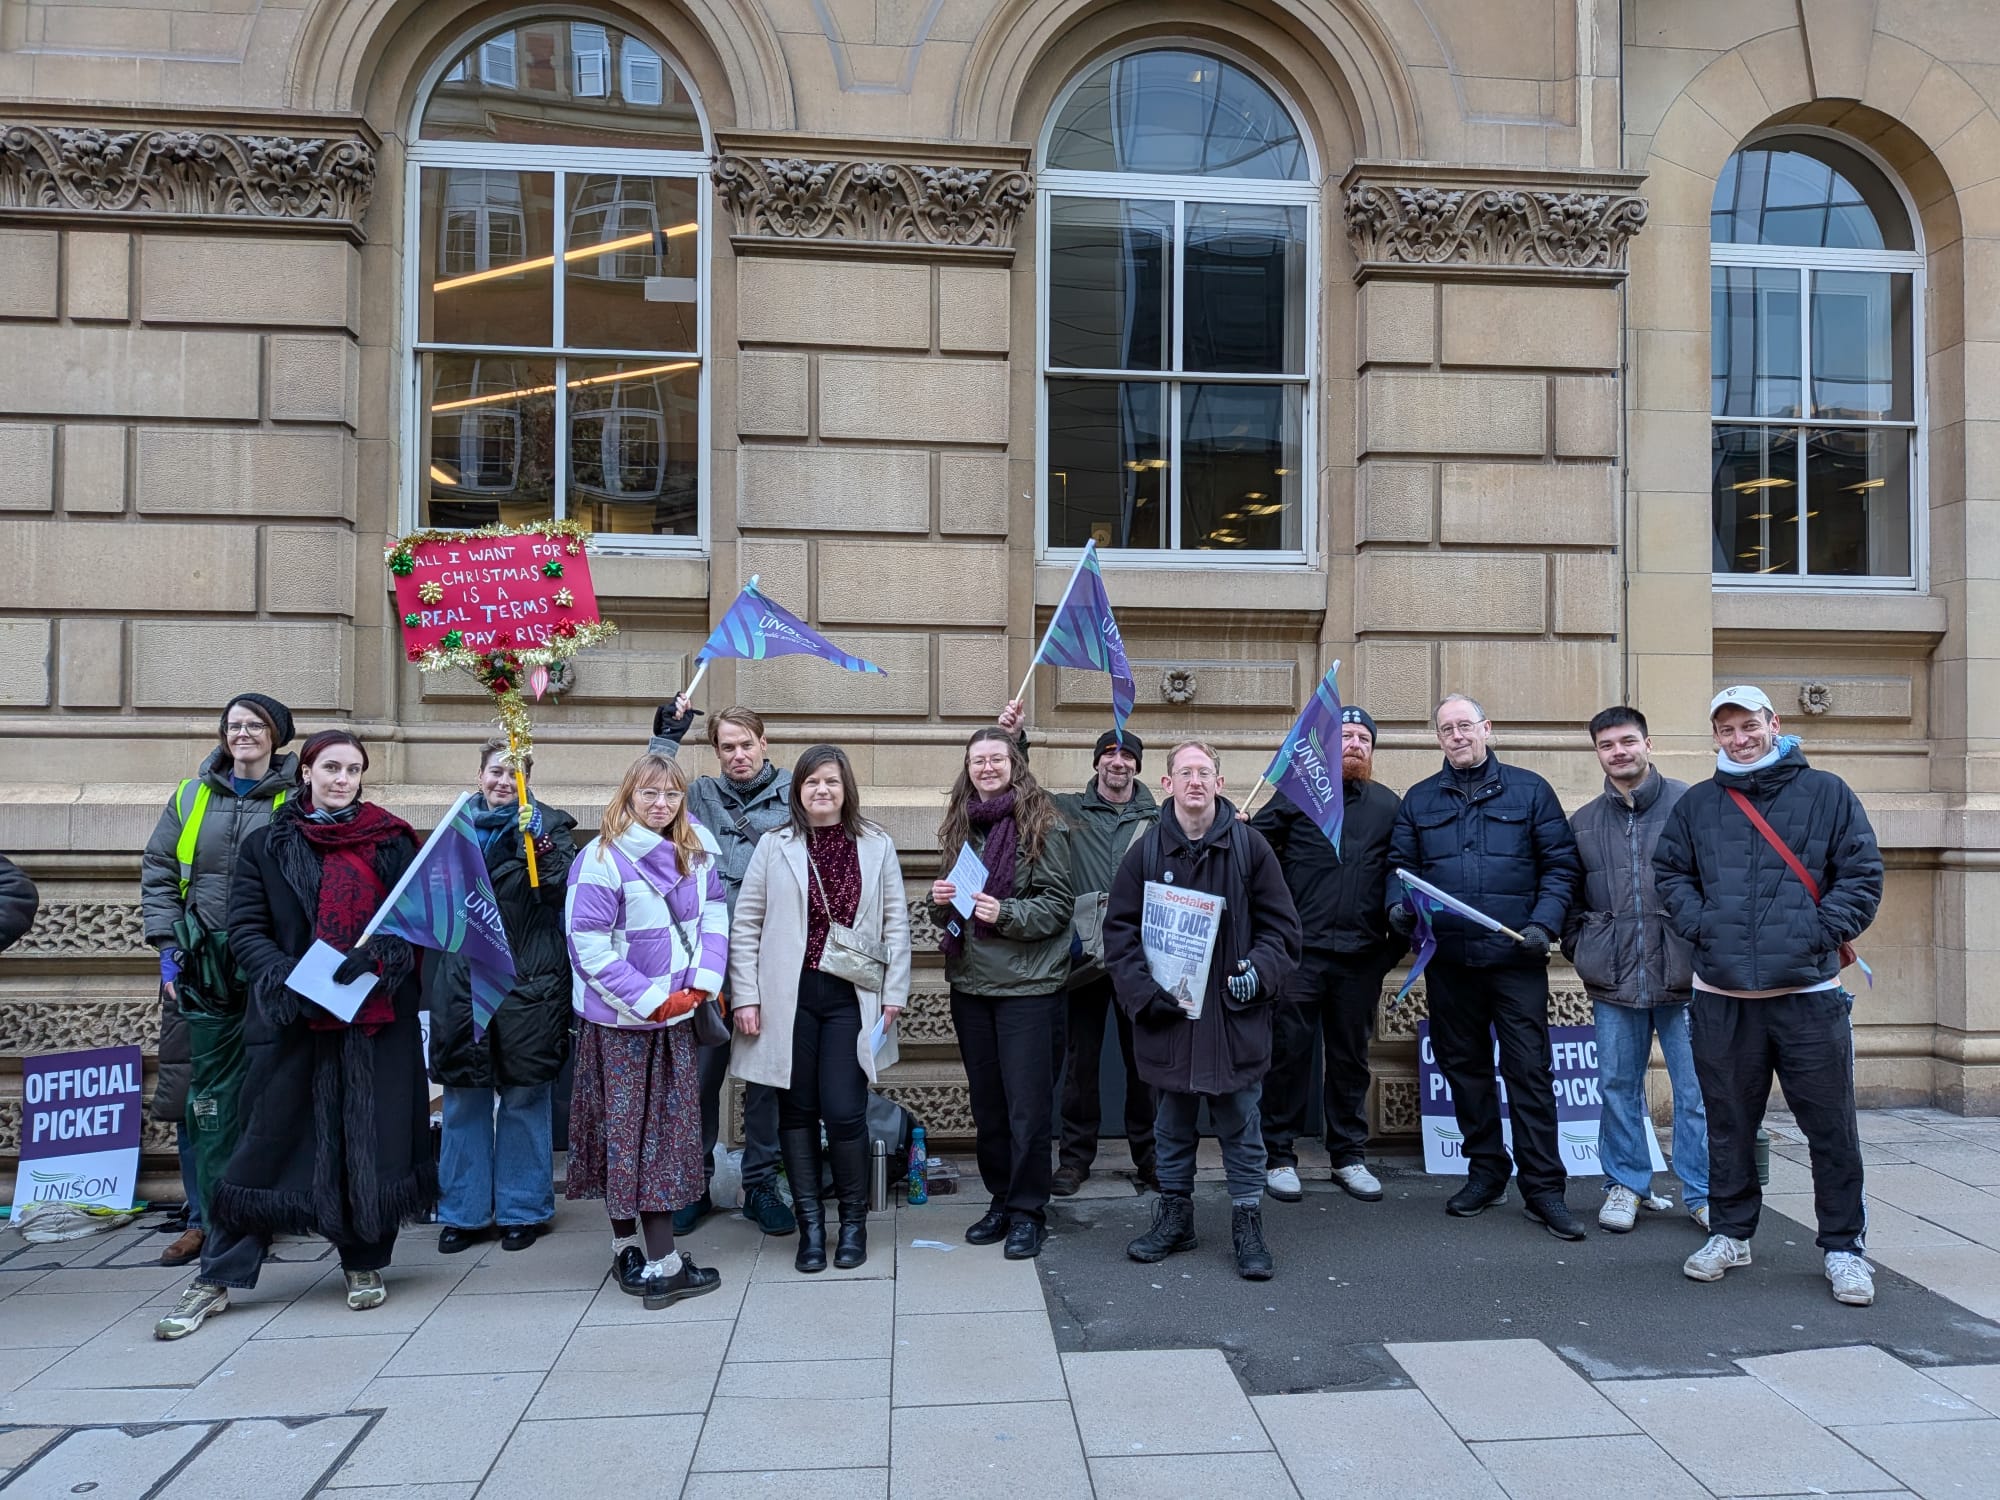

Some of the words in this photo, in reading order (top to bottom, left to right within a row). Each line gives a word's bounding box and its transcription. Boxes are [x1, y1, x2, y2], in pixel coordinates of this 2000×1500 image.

[415, 555, 442, 568] ALL
[448, 552, 460, 564] I
[468, 546, 516, 562] WANT
[531, 544, 562, 559] FOR
[441, 565, 540, 586] CHRISTMAS
[463, 586, 480, 603] IS
[498, 586, 509, 600] A
[420, 606, 471, 628] REAL
[479, 597, 548, 624] TERMS
[464, 629, 497, 647] PAY
[515, 623, 554, 642] RISE
[1283, 749, 1292, 759] the
[1287, 759, 1304, 777] public
[1293, 737, 1335, 804] UNISON
[1301, 777, 1315, 797] service
[1311, 797, 1324, 814] union
[1164, 890, 1216, 912] Socialist
[464, 891, 508, 941] UNIS
[1144, 902, 1177, 929] FUND
[1177, 911, 1212, 939] OUR
[464, 917, 486, 934] public
[484, 933, 506, 951] service
[1143, 924, 1165, 951] NHS
[25, 1063, 140, 1104] OFFICIAL
[1552, 1077, 1603, 1107] PICK
[32, 1103, 125, 1143] PICKET
[33, 1176, 119, 1201] UNISON
